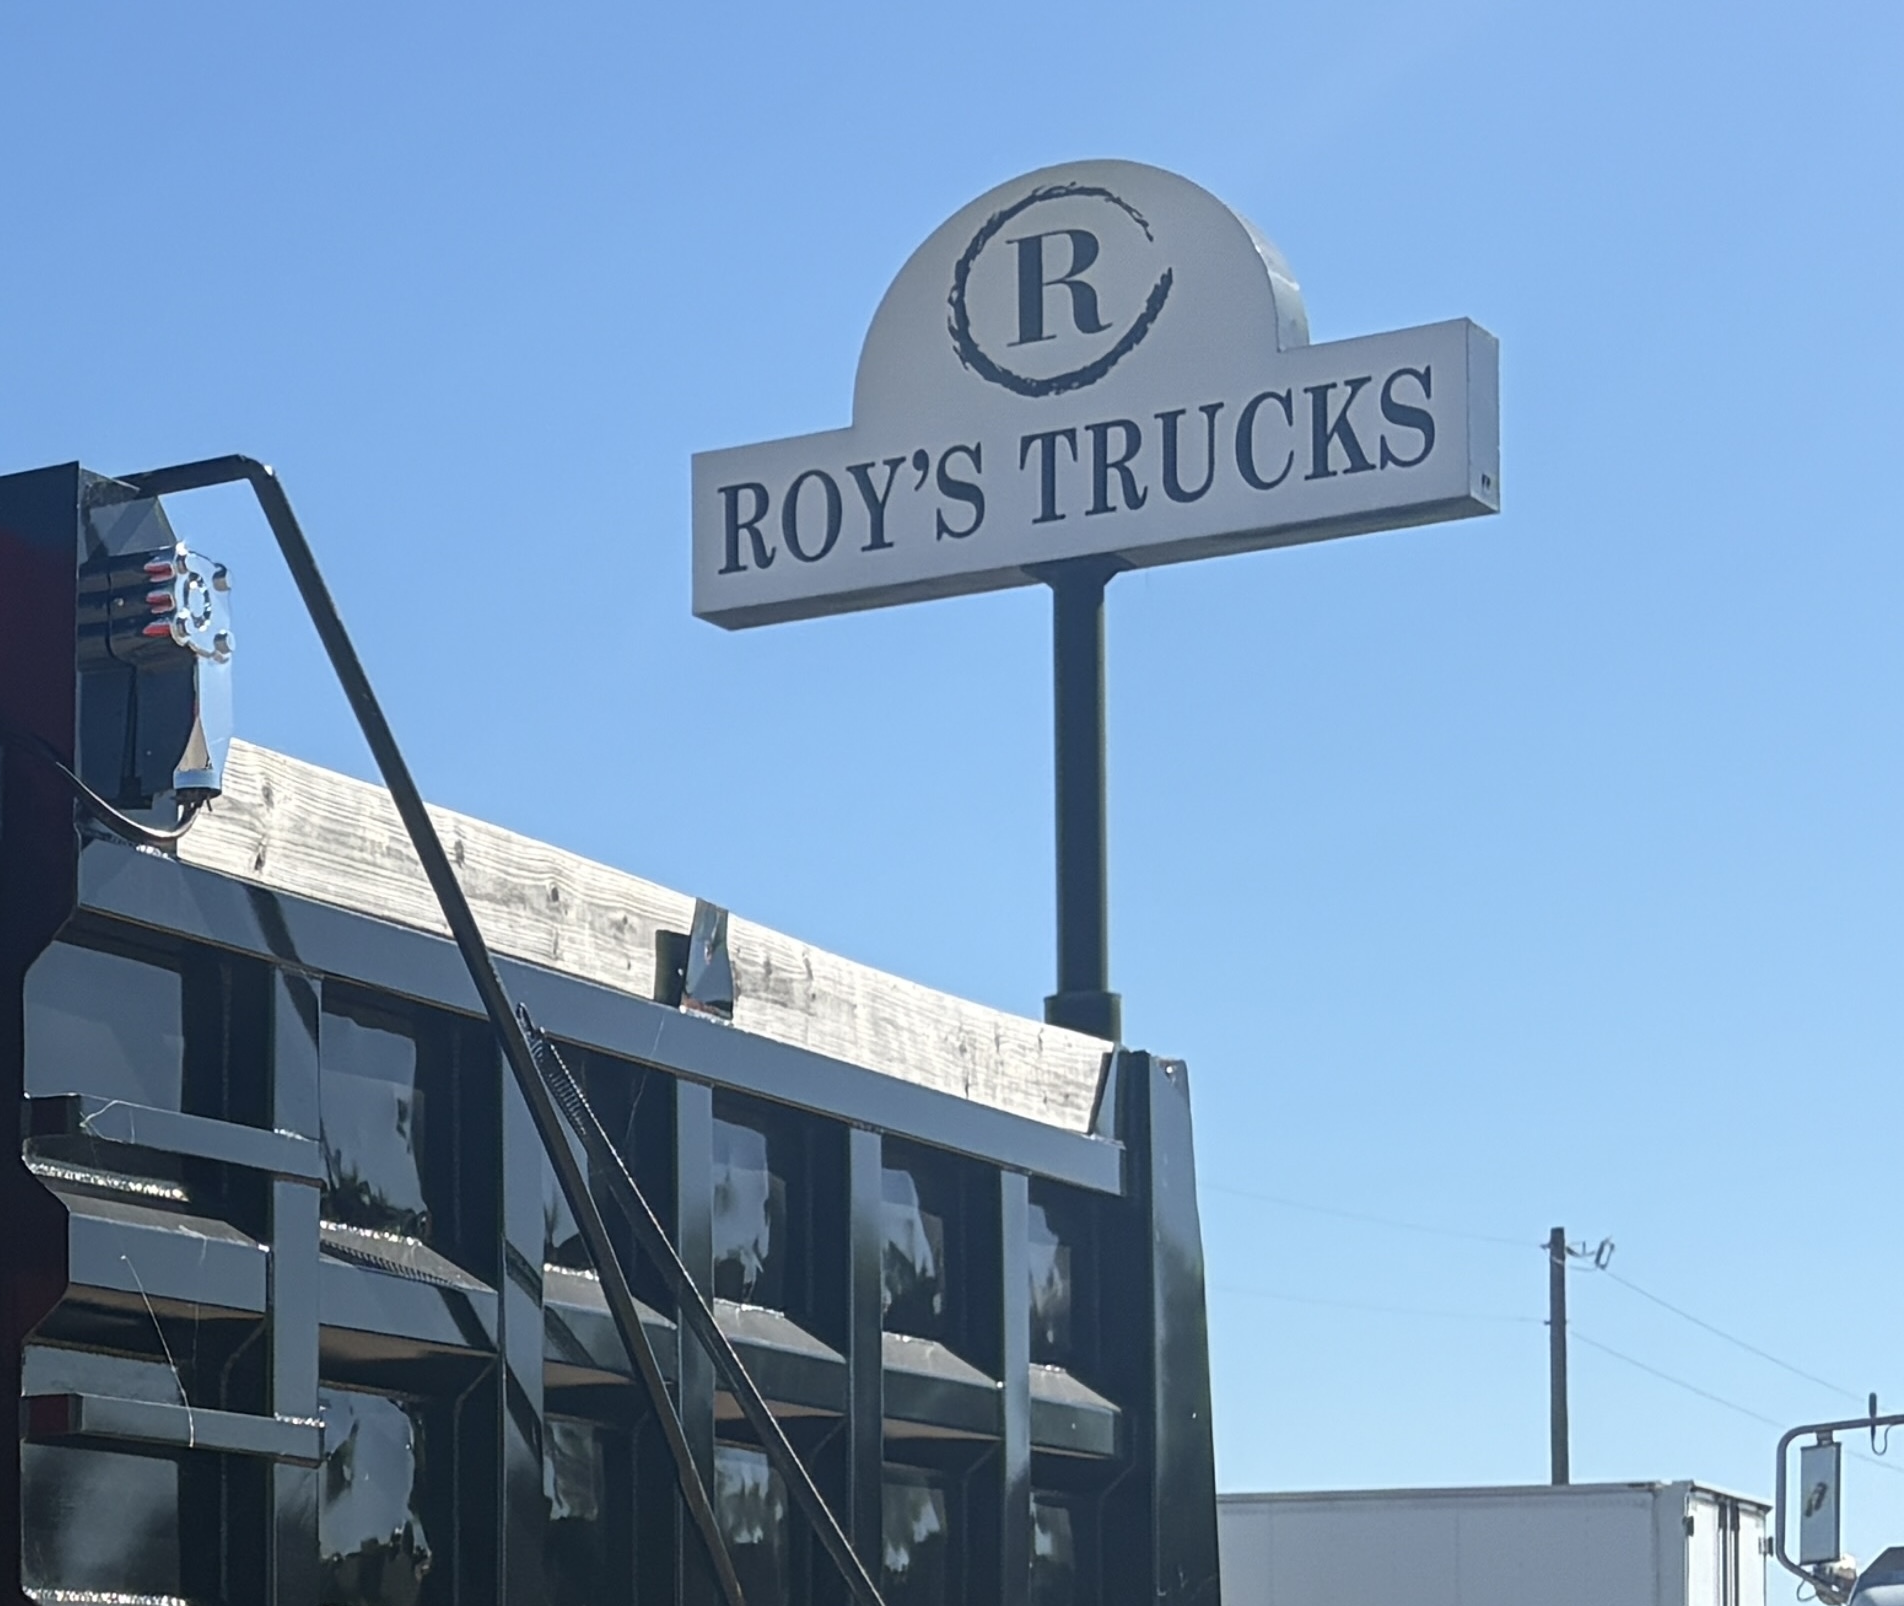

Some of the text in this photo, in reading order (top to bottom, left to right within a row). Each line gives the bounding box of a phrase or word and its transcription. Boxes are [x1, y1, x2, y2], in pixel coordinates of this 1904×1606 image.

[1005, 228, 1113, 347] R
[717, 365, 1437, 577] ROY'S TRUCKS
